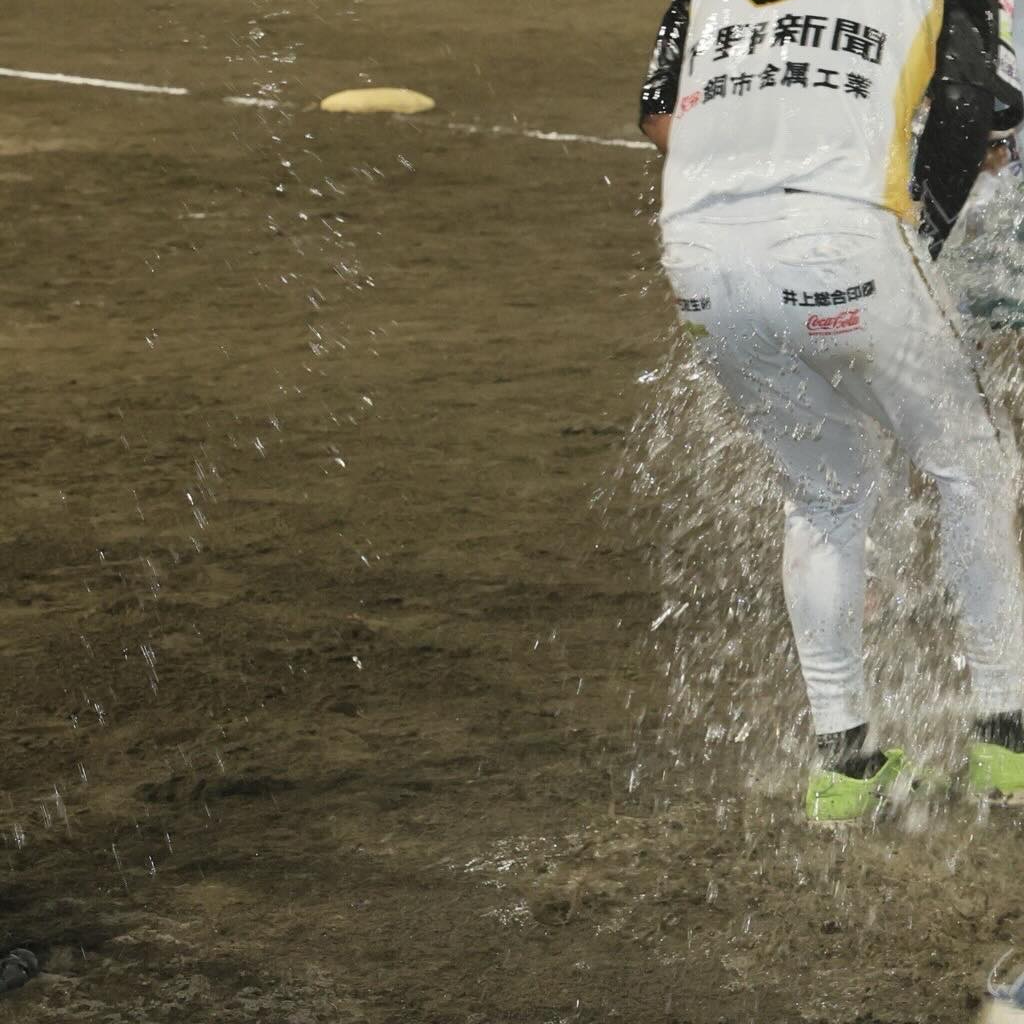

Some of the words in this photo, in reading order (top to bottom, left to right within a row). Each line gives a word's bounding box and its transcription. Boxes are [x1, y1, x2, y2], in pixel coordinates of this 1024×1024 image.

[702, 61, 873, 104] 銅市金属工業
